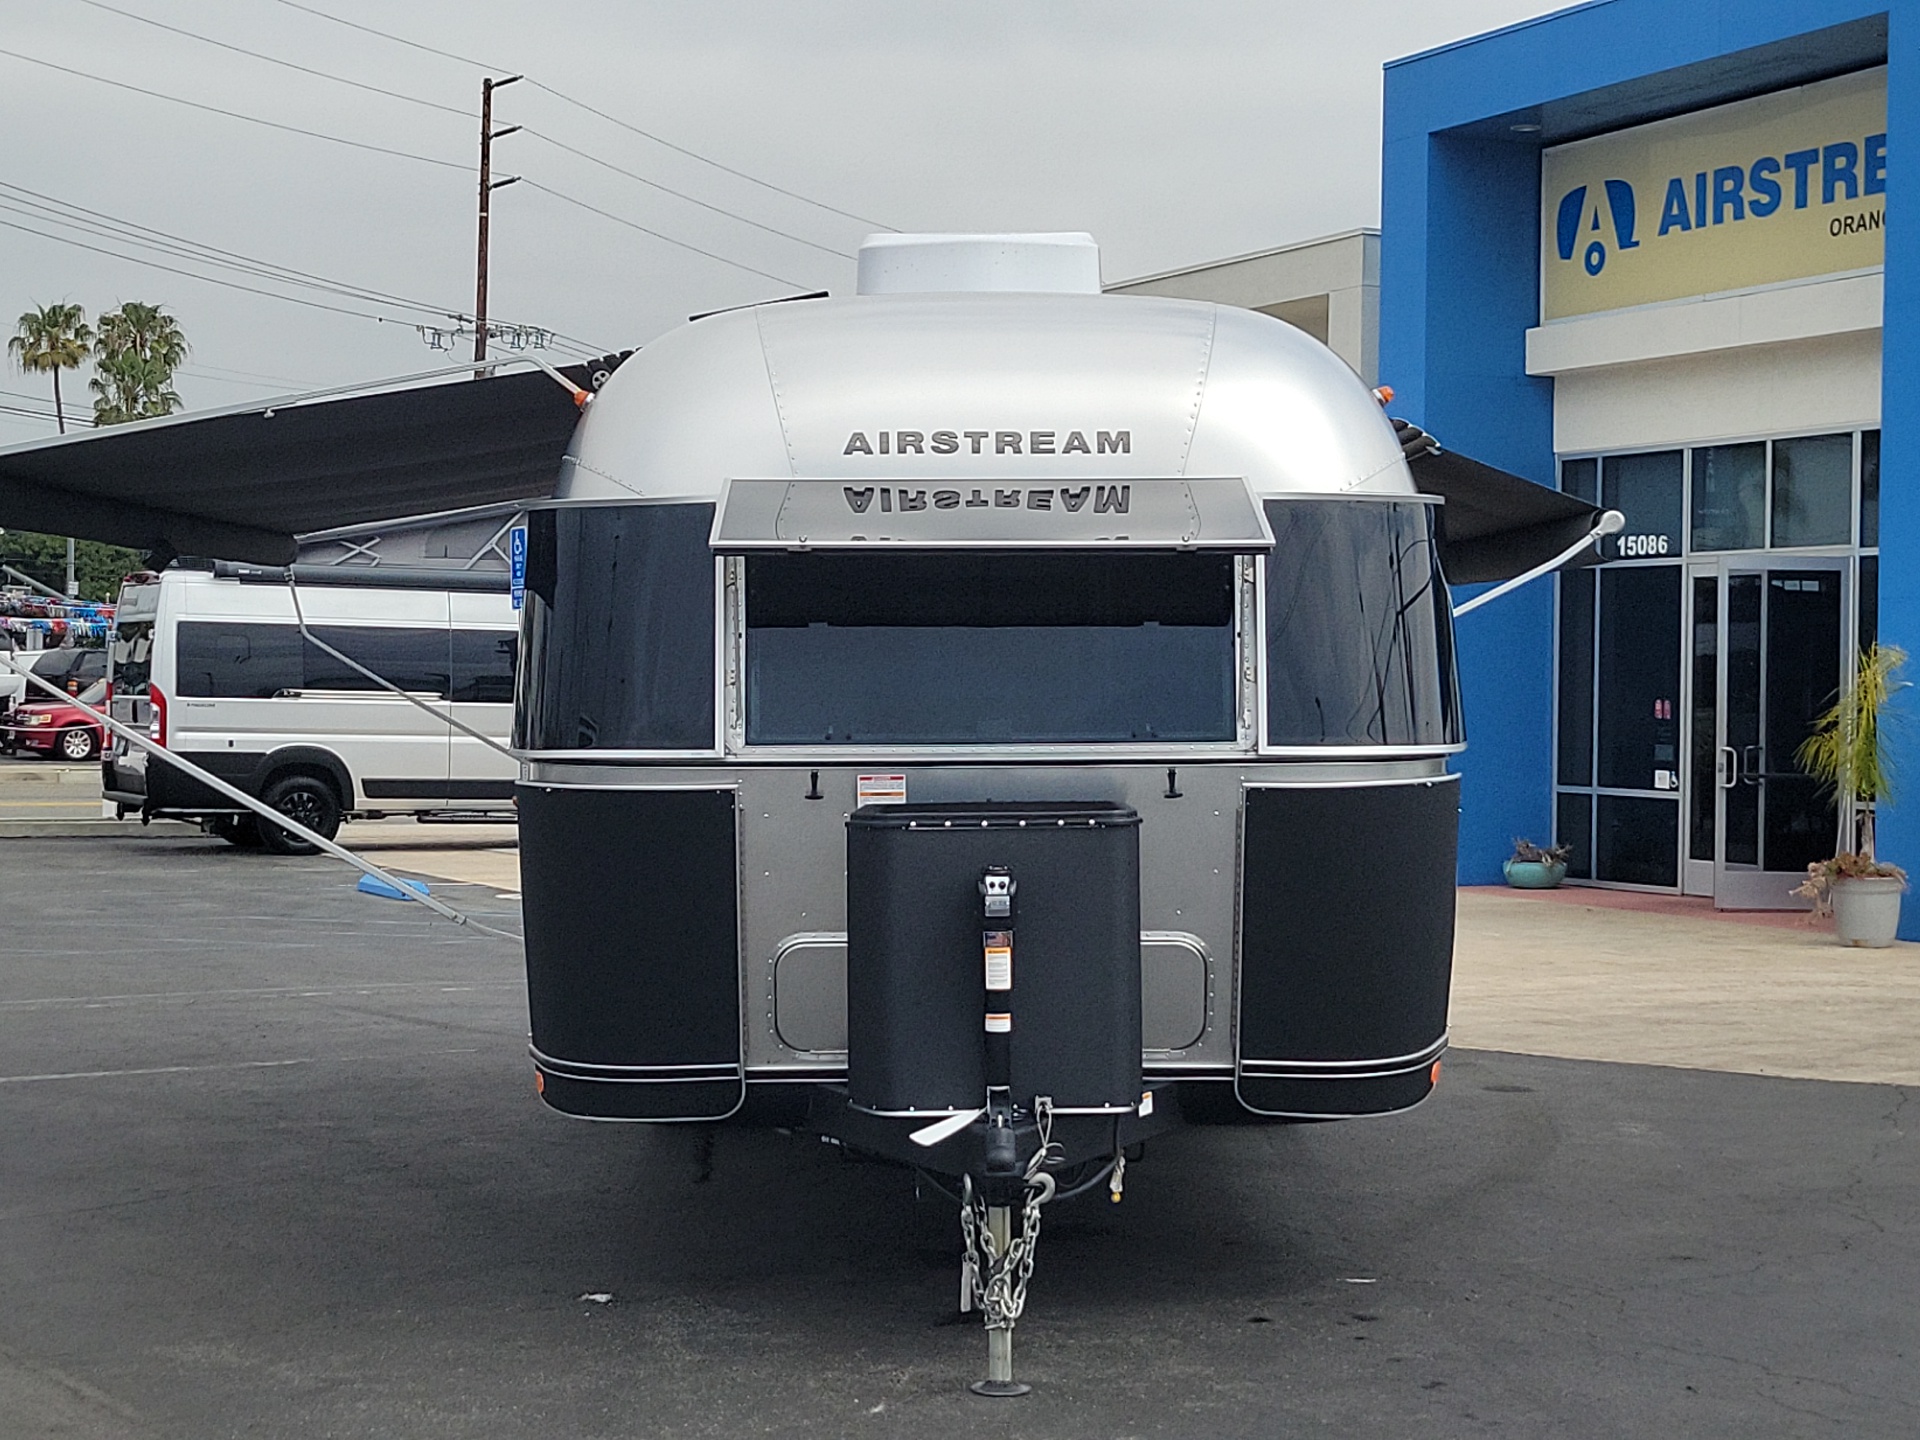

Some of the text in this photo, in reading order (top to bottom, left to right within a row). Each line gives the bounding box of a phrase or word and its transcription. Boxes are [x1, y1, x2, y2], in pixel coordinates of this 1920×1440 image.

[1658, 133, 1887, 237] AIRSTRE
[1829, 209, 1886, 237] ORAN
[843, 431, 1131, 455] AIRSTREAM
[1617, 534, 1668, 556] 15086
